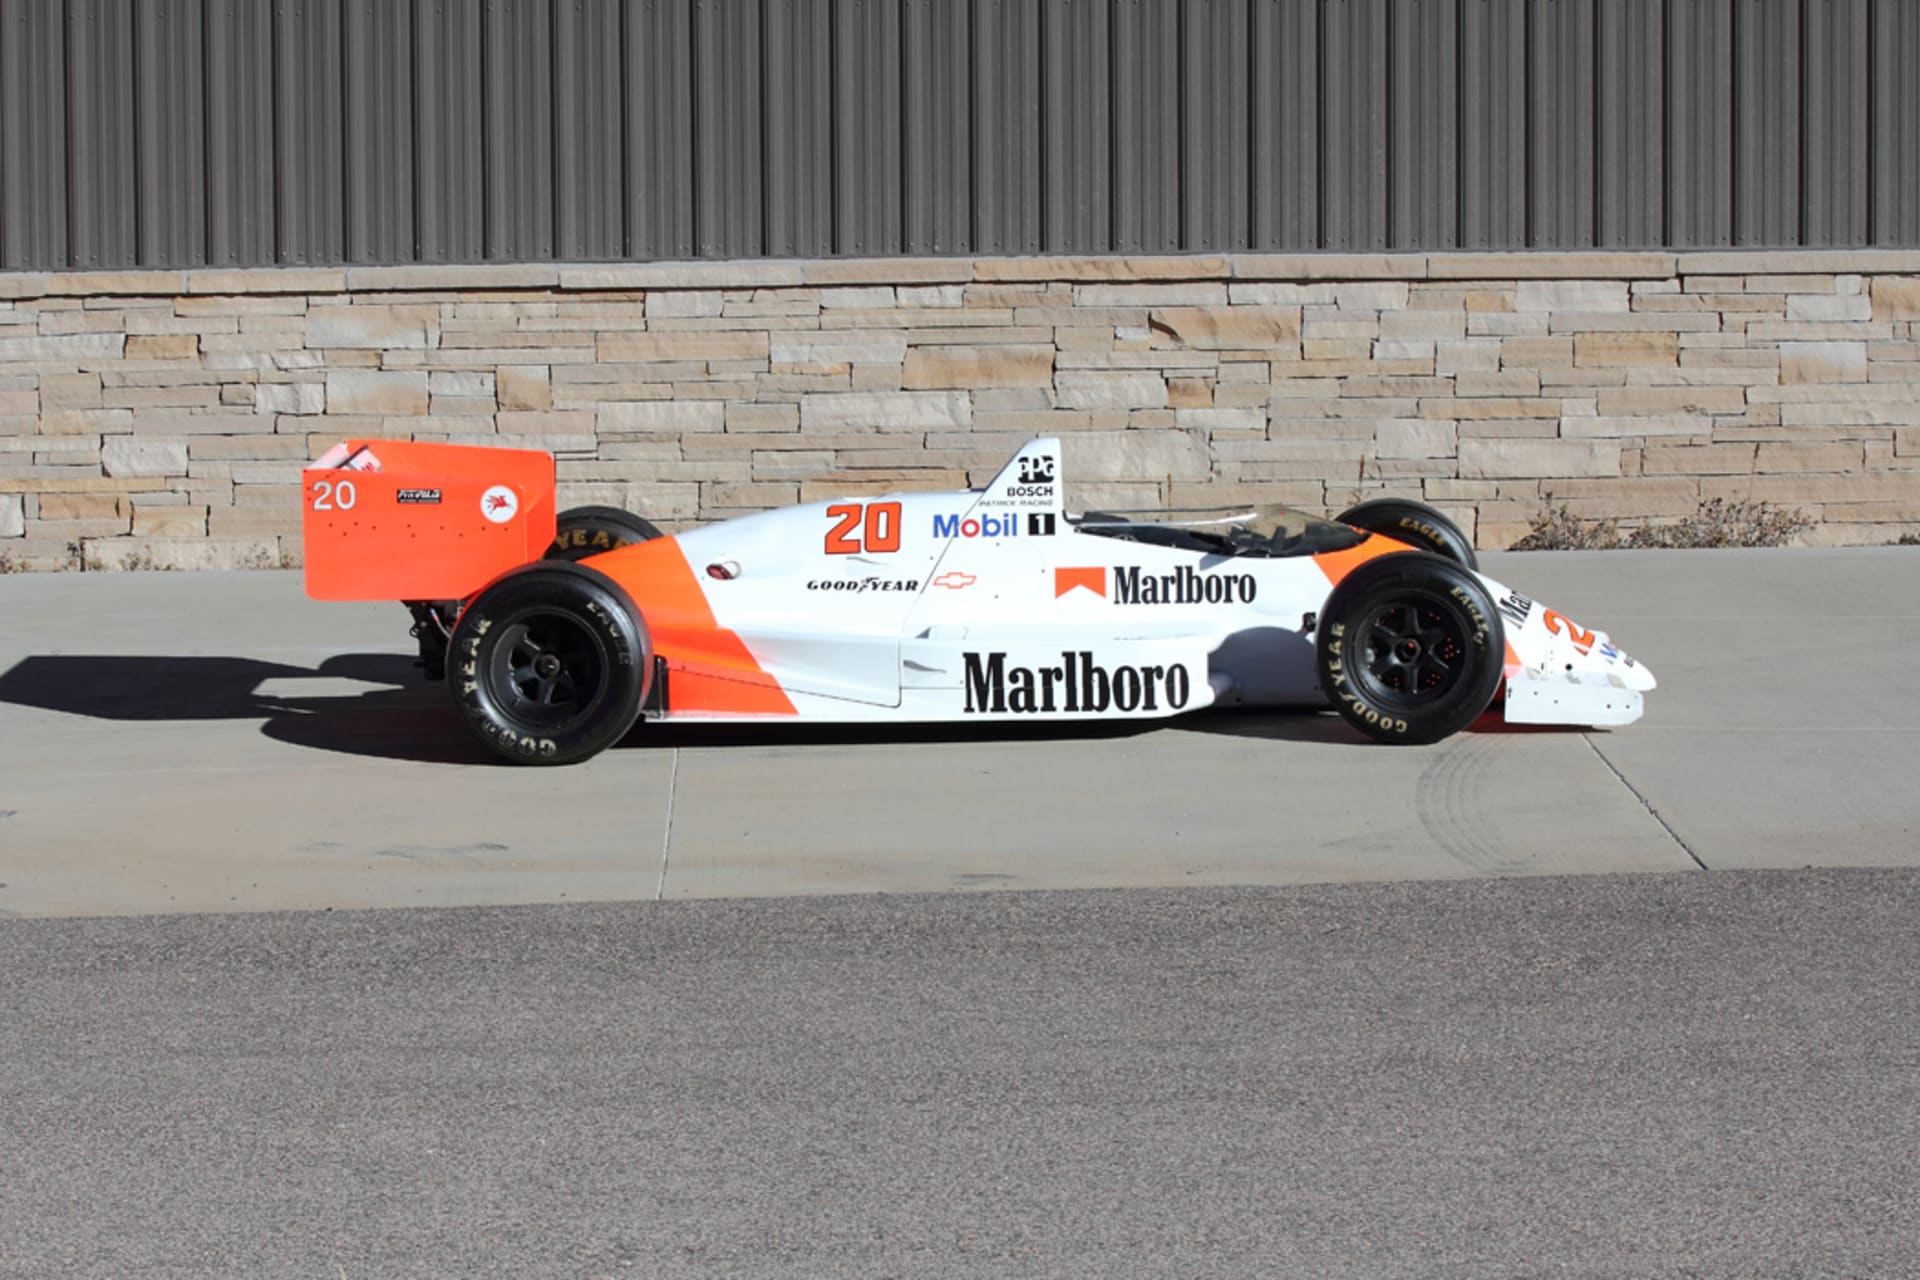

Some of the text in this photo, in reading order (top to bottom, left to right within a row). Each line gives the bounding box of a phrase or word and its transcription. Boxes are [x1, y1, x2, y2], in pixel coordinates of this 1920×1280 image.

[1018, 455, 1054, 484] PPG
[312, 480, 356, 510] 20
[1006, 486, 1054, 497] BOSCH
[824, 501, 902, 555] 20
[932, 513, 1052, 538] Mobil 1
[1399, 517, 1446, 547] EAGLE
[806, 576, 919, 593] GOODYEAR
[1113, 566, 1257, 605] Marlboro
[1450, 586, 1489, 632] EAGLE
[962, 651, 1190, 713] Marlboro
